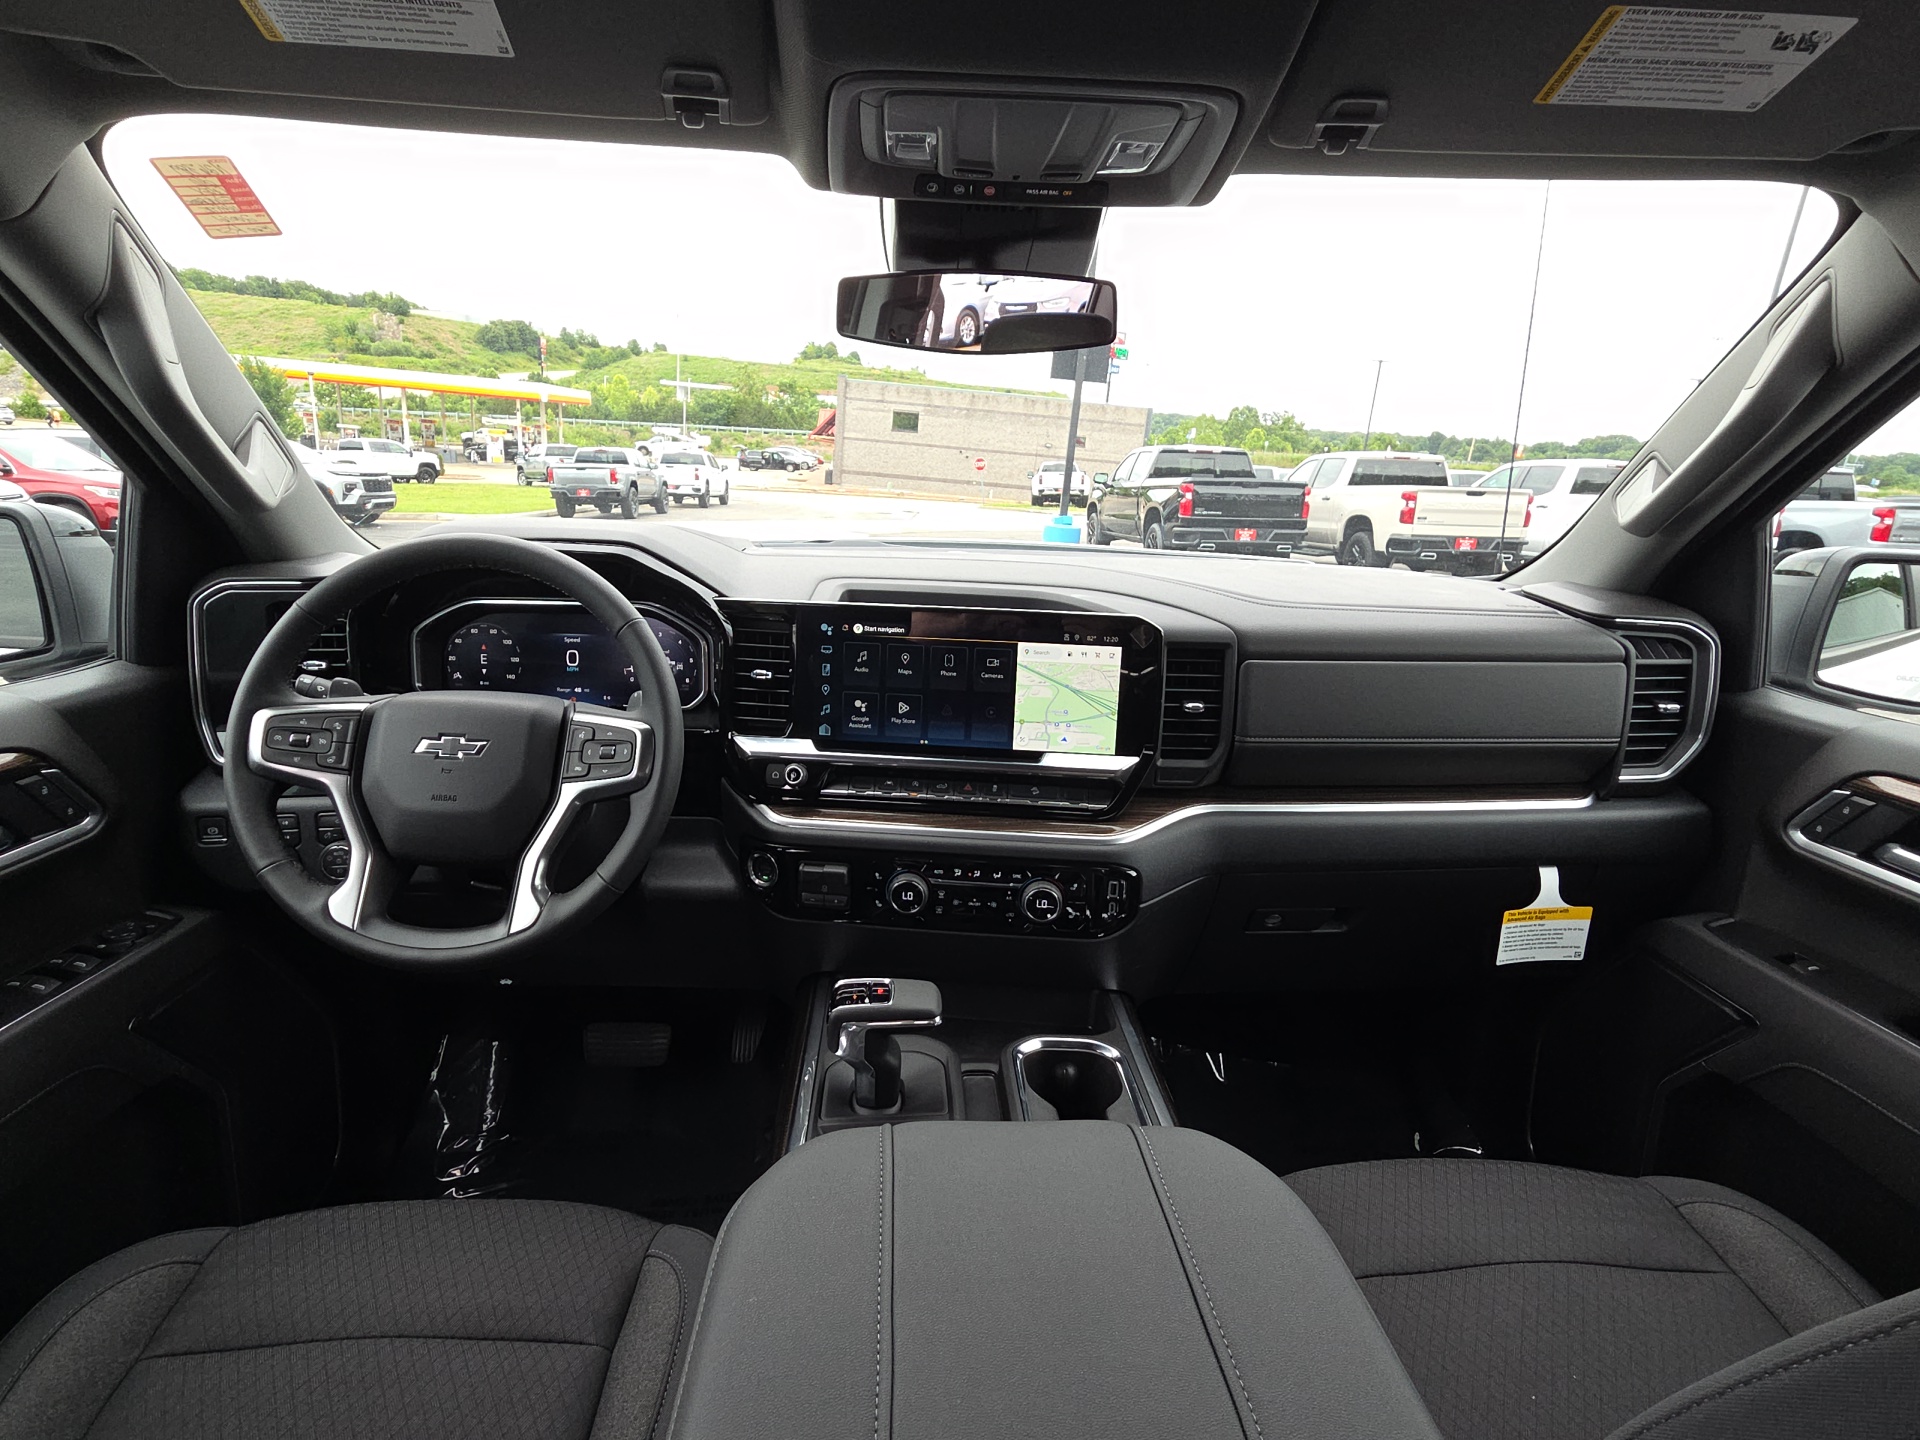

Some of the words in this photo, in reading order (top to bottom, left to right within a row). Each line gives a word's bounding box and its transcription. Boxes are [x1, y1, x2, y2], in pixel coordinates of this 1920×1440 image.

[1626, 8, 1651, 16] EVEN
[1649, 9, 1674, 17] WITH
[1674, 10, 1723, 19] ADVANCED
[1739, 13, 1765, 21] BAGS
[1631, 58, 1648, 66] DES
[877, 626, 905, 634] navigation
[480, 653, 488, 664] E
[566, 649, 579, 667] 0
[850, 715, 870, 723] Google
[891, 717, 902, 725] Play
[430, 794, 458, 802] AIRBAG
[902, 891, 914, 901] LO
[1036, 899, 1048, 908] LO
